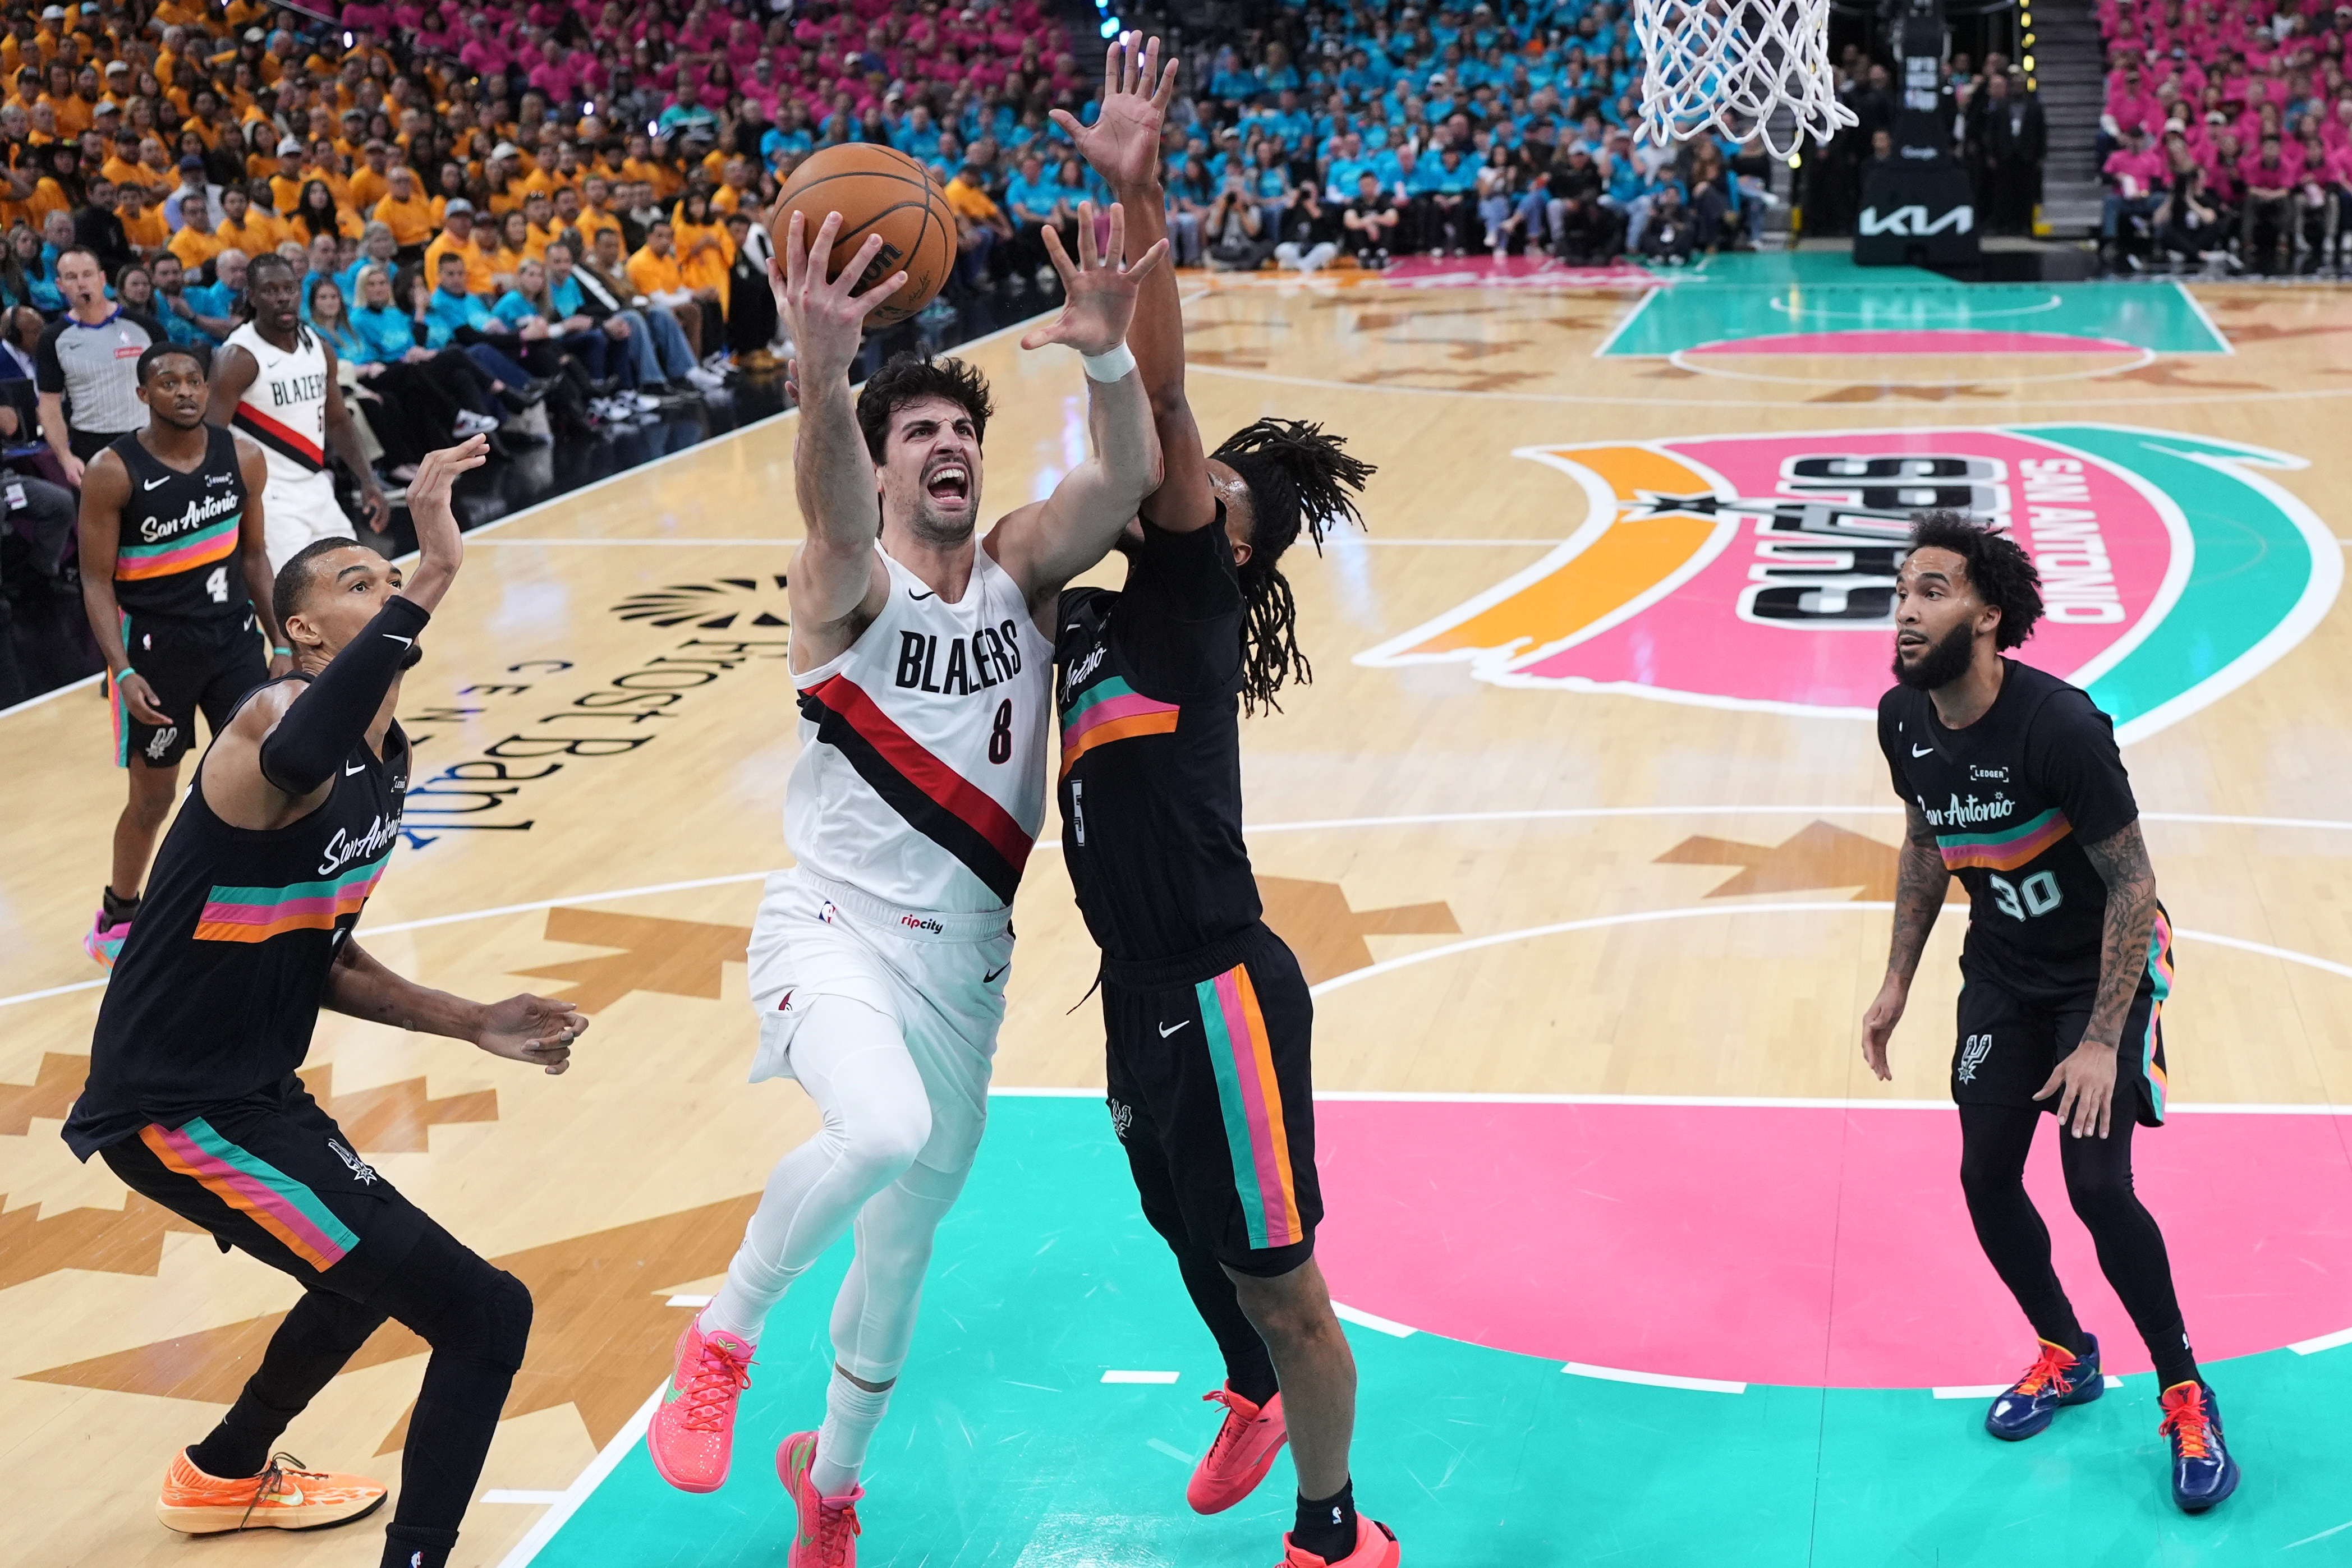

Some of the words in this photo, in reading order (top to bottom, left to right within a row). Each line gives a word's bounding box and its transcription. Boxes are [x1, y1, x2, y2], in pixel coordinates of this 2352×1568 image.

[2019, 458, 2092, 503] SAN
[140, 516, 178, 542] San
[180, 490, 238, 528] Antonio
[205, 565, 229, 604] 4
[2027, 505, 2126, 624] ANTONIO
[989, 698, 1012, 765] 8
[1974, 769, 2004, 779] LEDGER
[1944, 791, 2015, 828] Antonio
[318, 827, 359, 875] San
[1990, 870, 2063, 922] 30
[901, 914, 944, 935] ripcity
